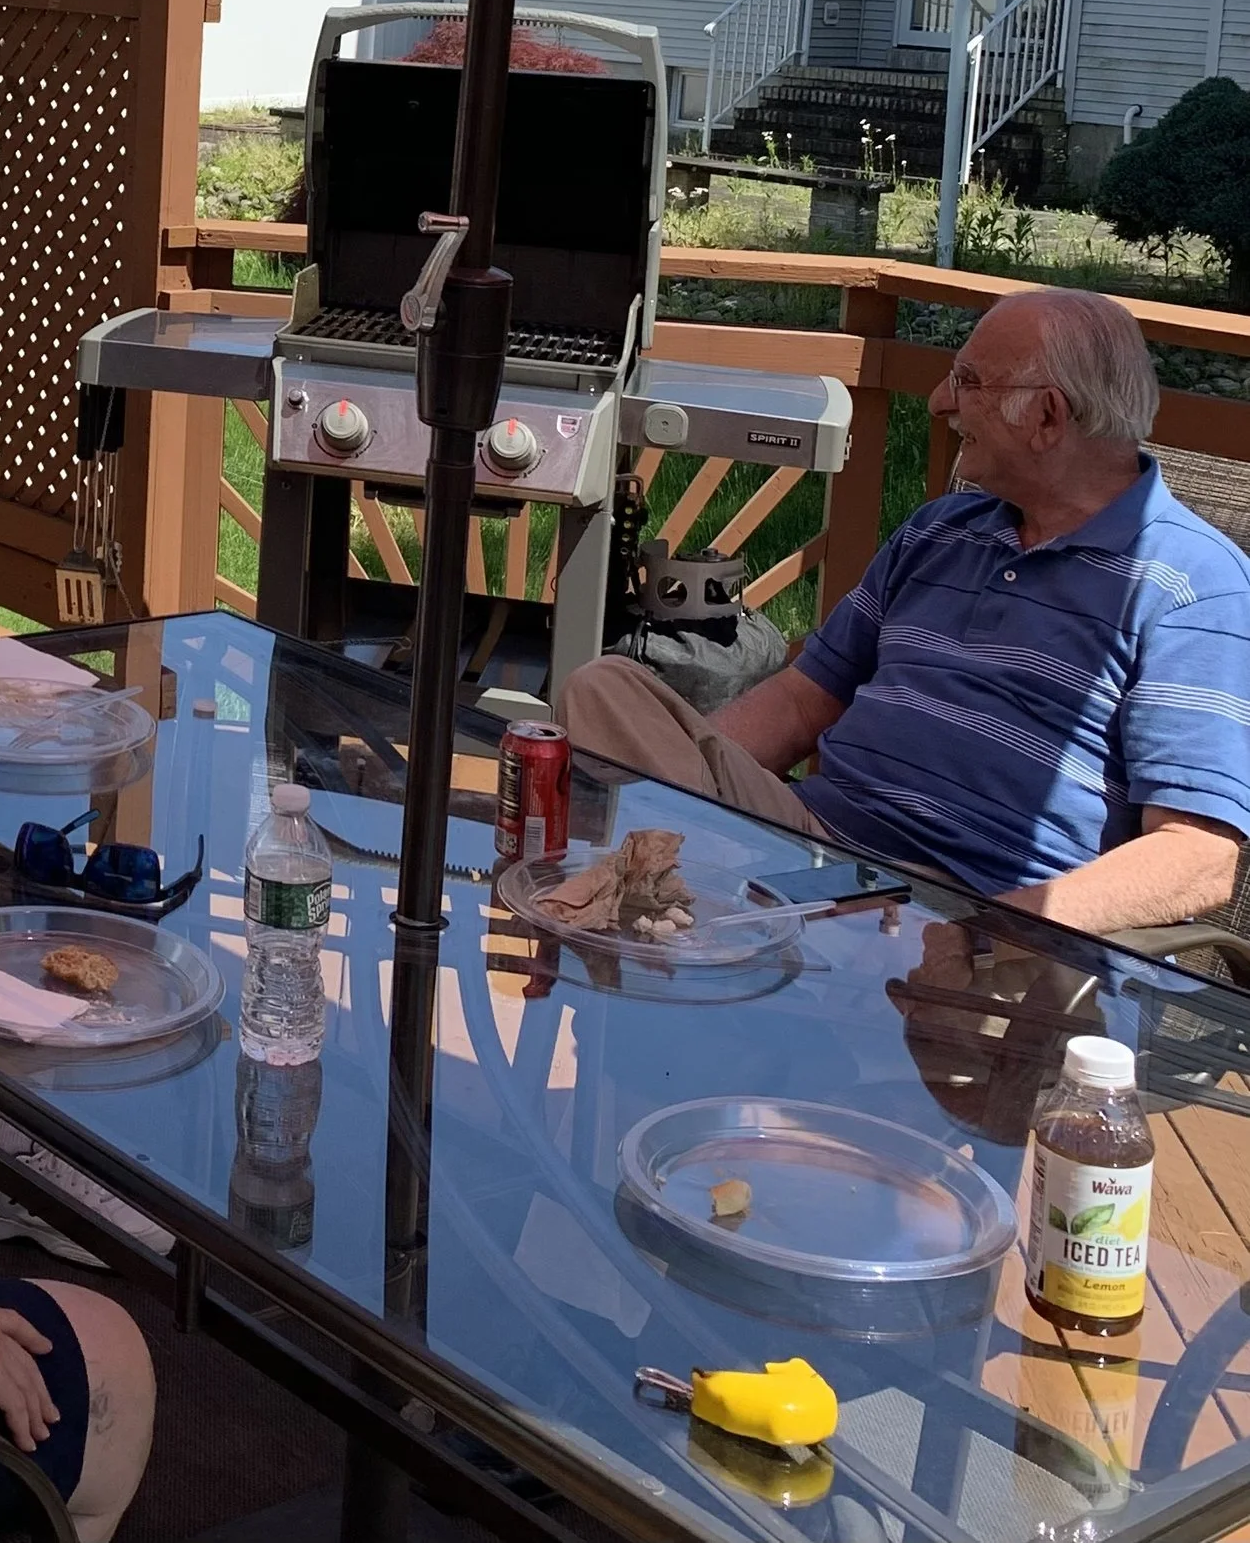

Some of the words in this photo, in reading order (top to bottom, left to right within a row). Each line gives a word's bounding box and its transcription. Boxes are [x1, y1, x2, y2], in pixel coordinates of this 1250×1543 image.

[750, 433, 788, 445] SPIRIT
[790, 438, 798, 447] II
[1091, 1179, 1133, 1196] Wawa
[1095, 1235, 1121, 1246] diet
[1063, 1238, 1109, 1267] ICED
[1114, 1244, 1141, 1268] TEA
[1082, 1278, 1126, 1291] Lemon
